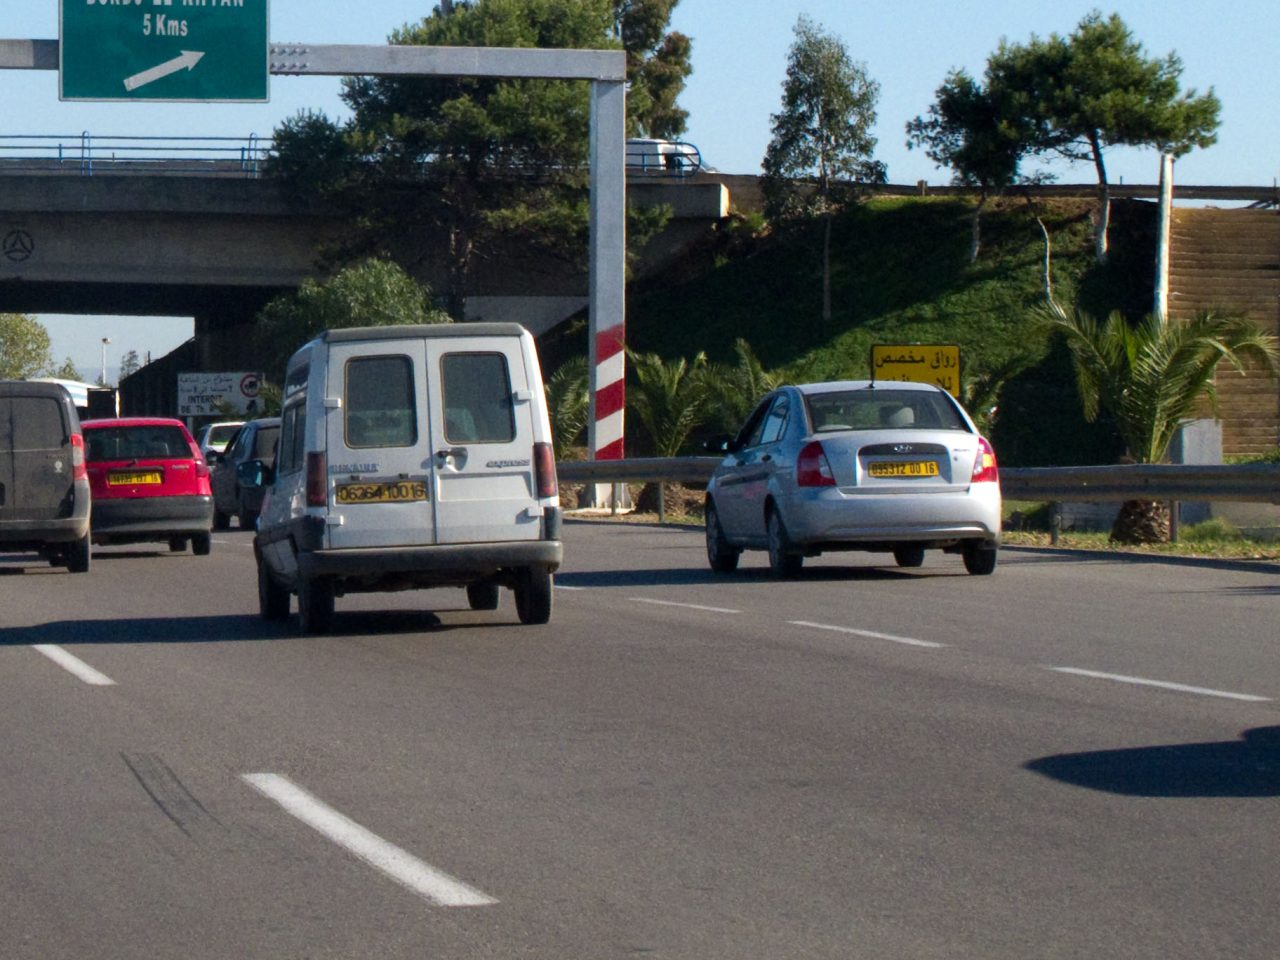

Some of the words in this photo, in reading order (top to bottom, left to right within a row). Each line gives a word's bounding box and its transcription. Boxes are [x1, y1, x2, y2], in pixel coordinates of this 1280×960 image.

[143, 13, 151, 36] 5
[156, 14, 188, 37] Kms
[875, 351, 925, 367] مخصص
[930, 351, 956, 369] رواق
[925, 463, 935, 473] 16
